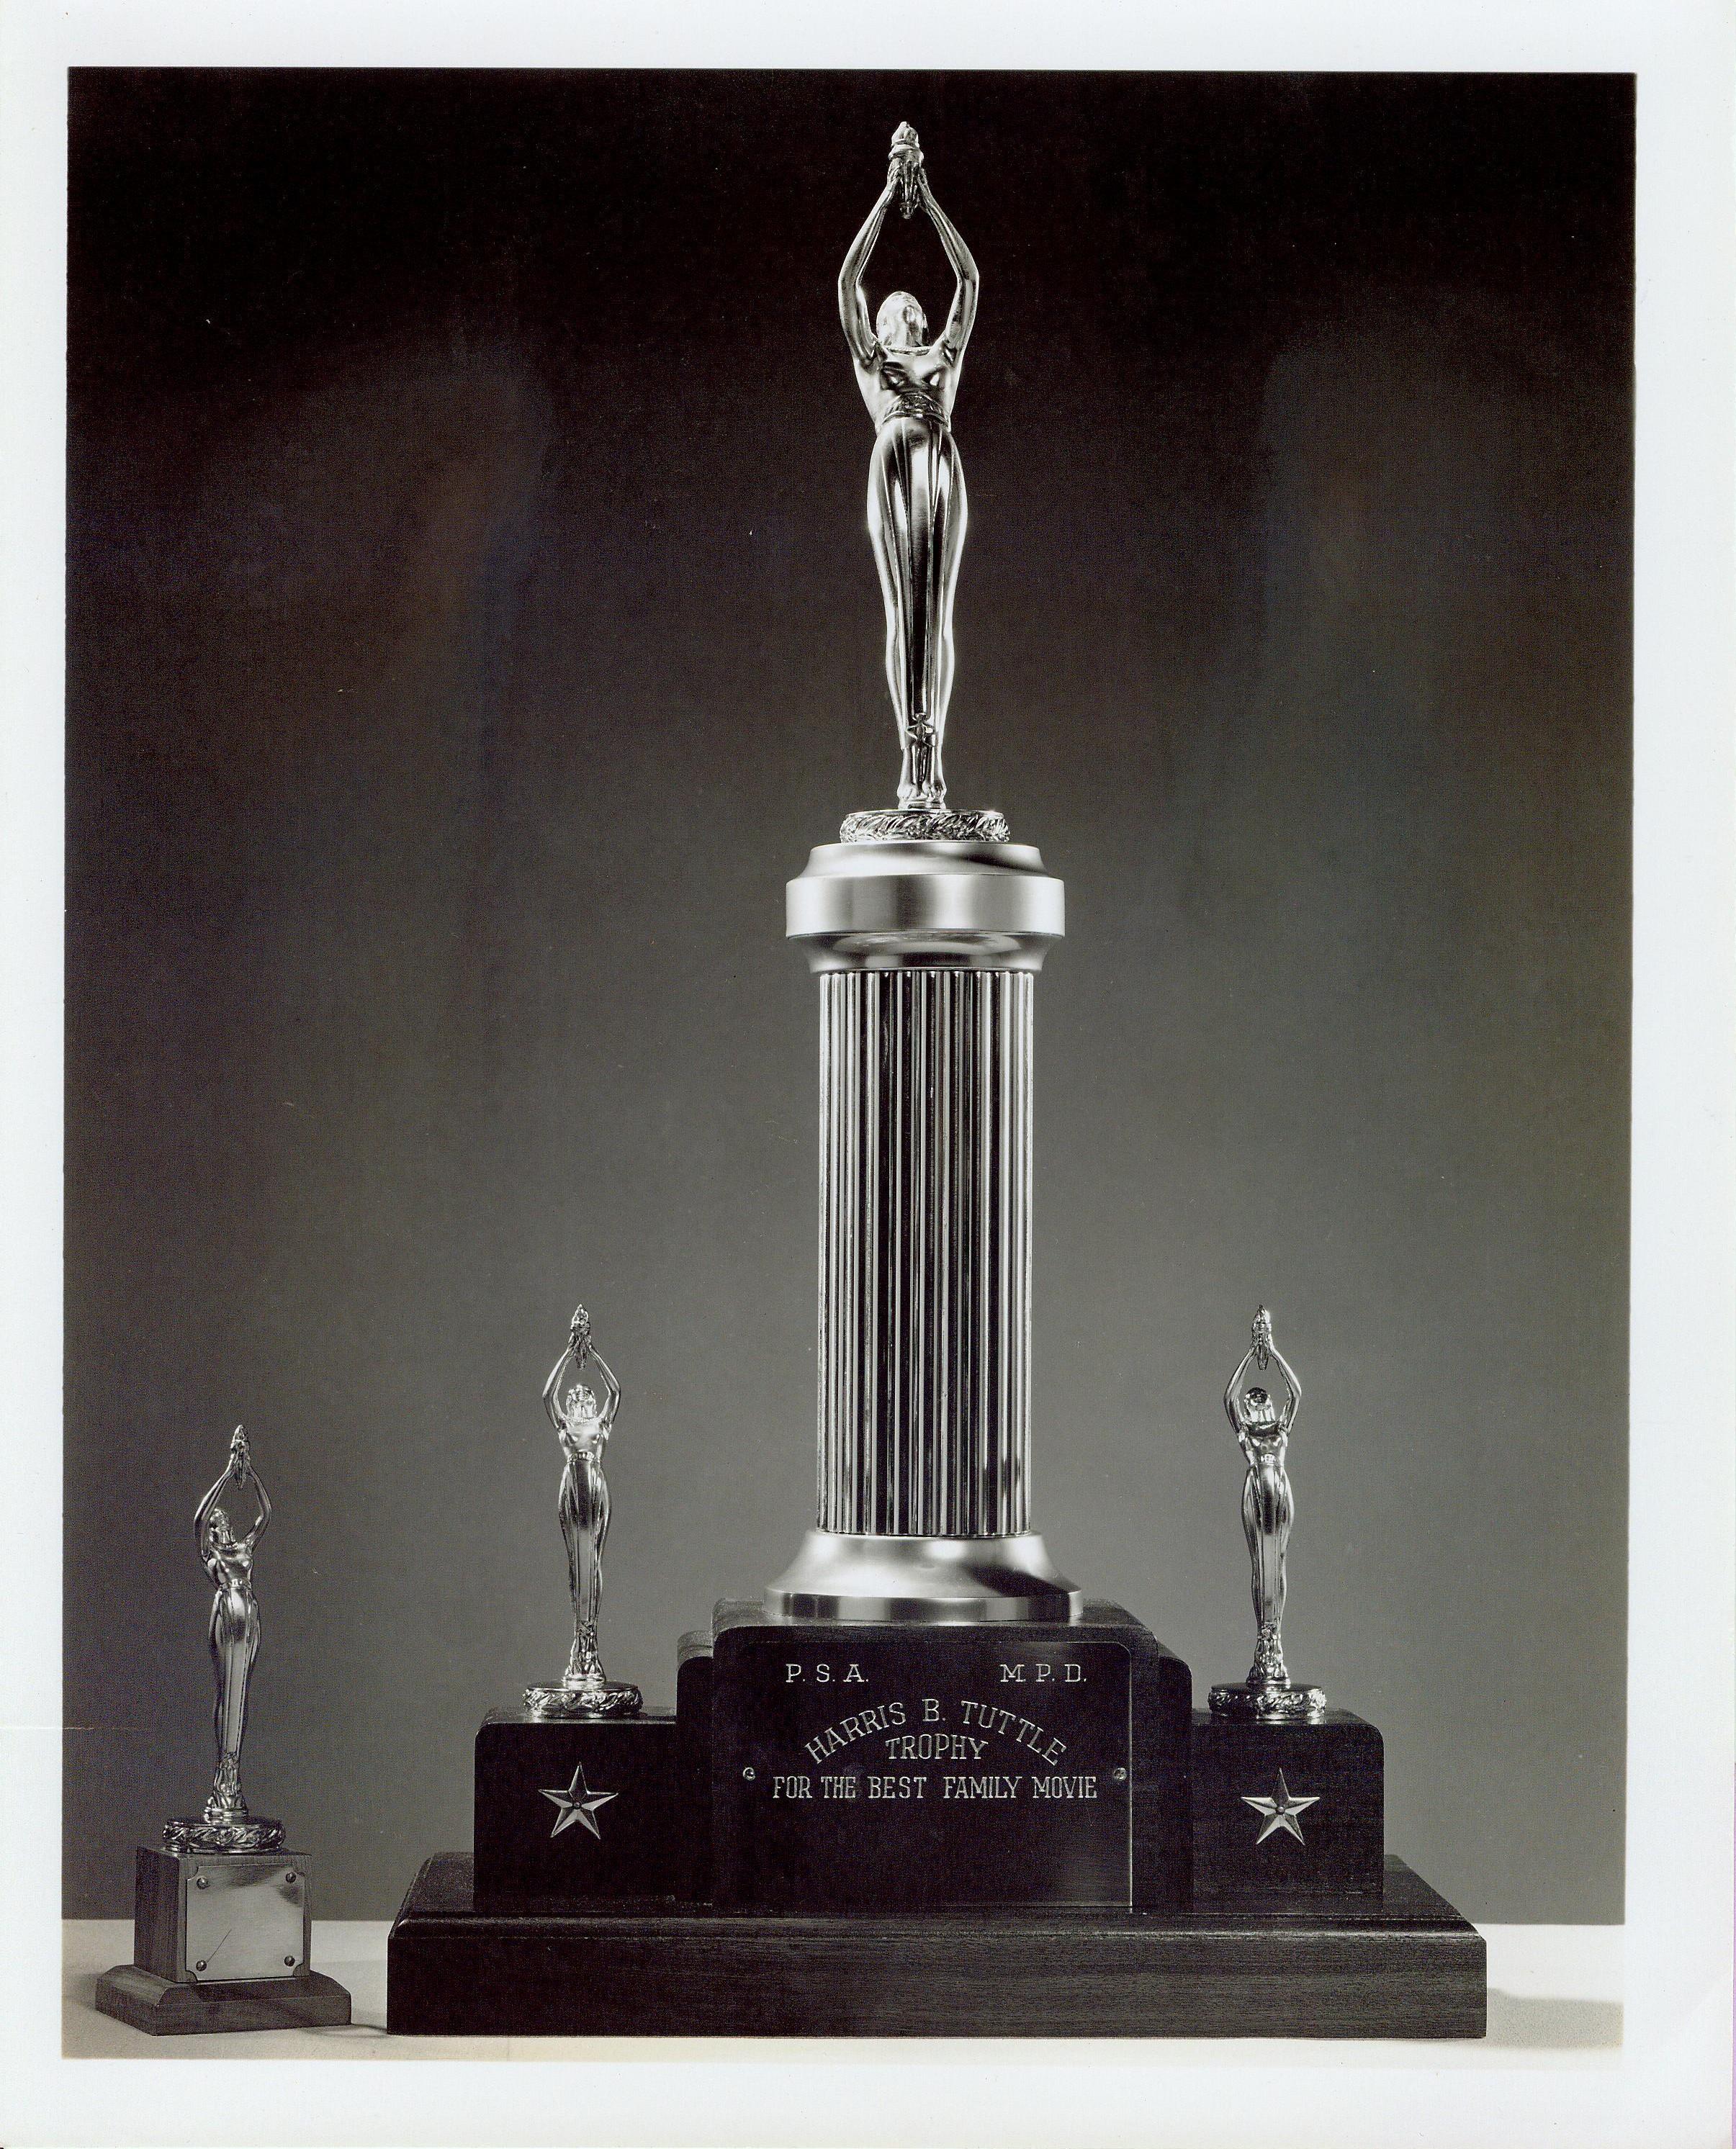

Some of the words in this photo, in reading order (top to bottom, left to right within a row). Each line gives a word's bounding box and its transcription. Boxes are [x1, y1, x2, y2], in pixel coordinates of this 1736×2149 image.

[805, 1703, 907, 1764] HARRIS
[922, 1699, 945, 1722] B.
[961, 1700, 1067, 1765] TUTTLE
[886, 1734, 988, 1759] TROPHY
[773, 1776, 812, 1799] FOR
[821, 1777, 856, 1799] THE
[868, 1776, 927, 1799] BEST
[943, 1777, 1022, 1799] FAMILY
[1032, 1776, 1097, 1799] MOVIE
